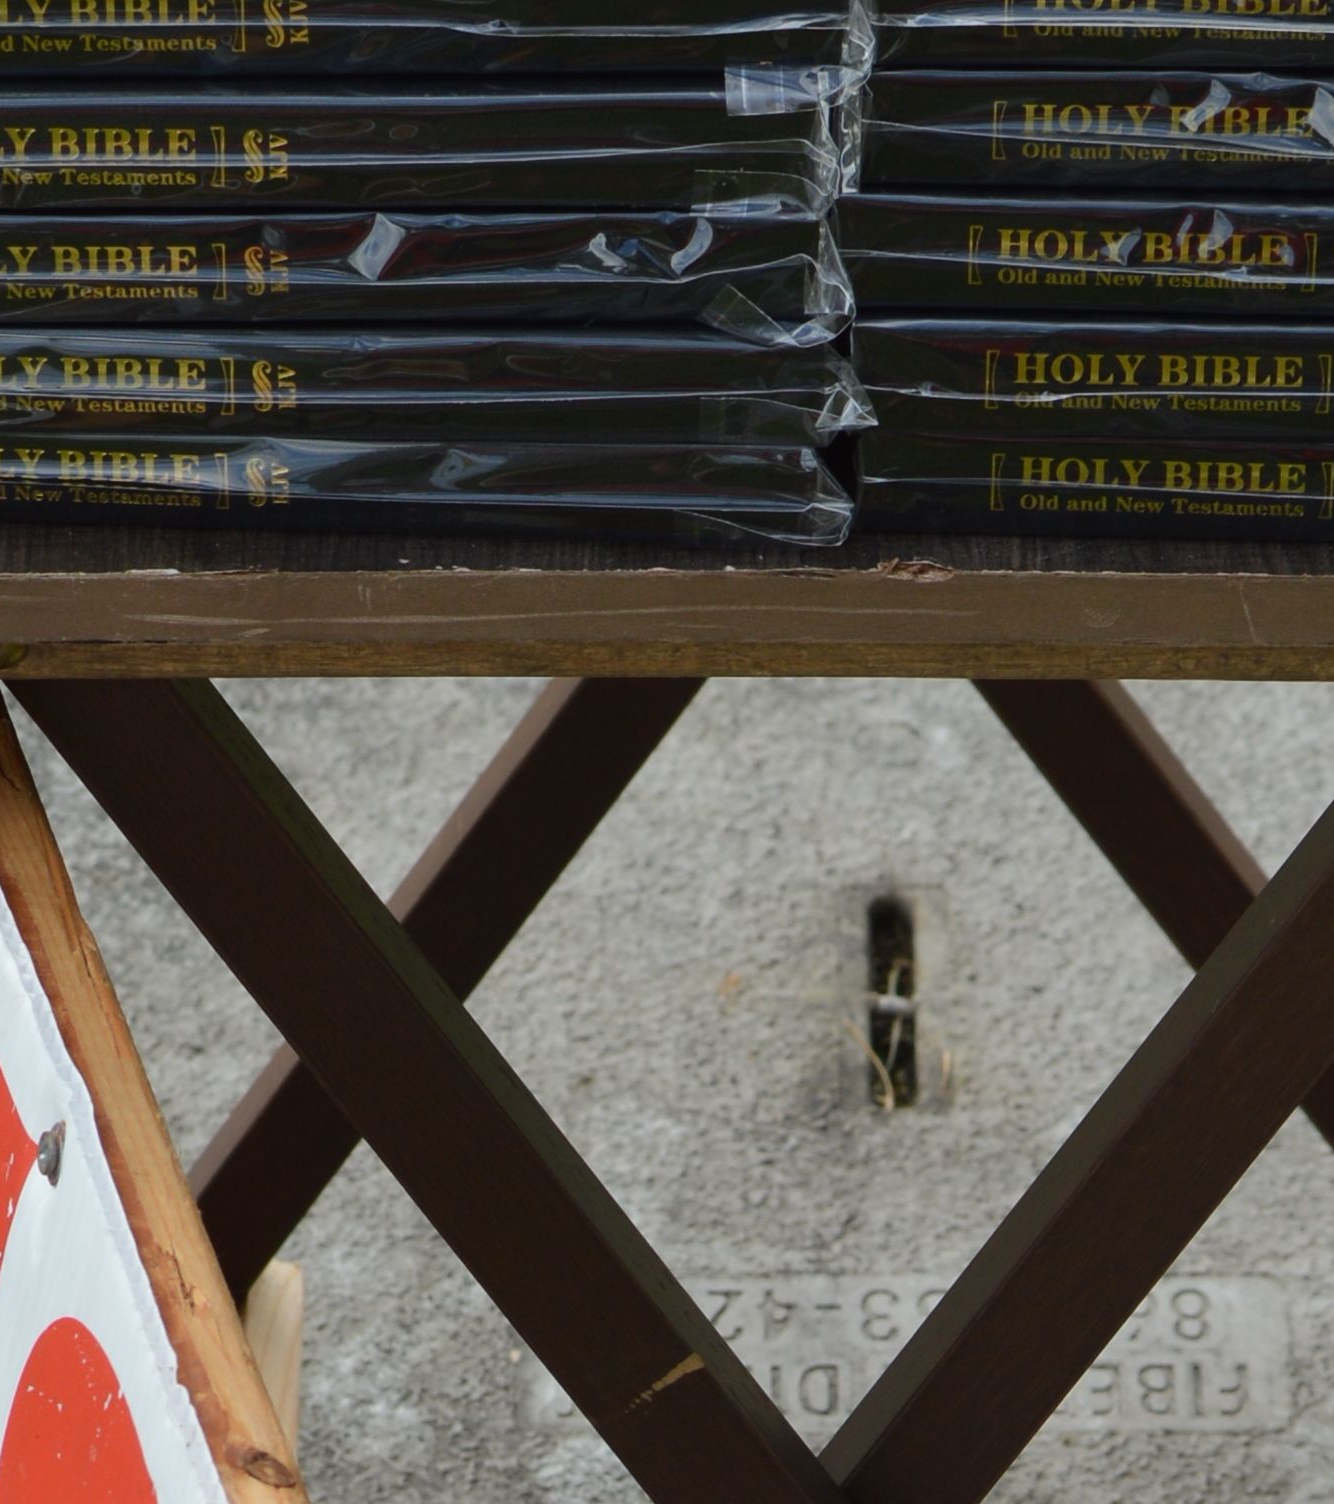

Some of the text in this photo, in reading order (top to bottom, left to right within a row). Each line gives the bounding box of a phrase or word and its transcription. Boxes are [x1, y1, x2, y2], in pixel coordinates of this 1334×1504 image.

[22, 35, 72, 53] New
[80, 34, 217, 52] Testaments
[1021, 105, 1155, 136] HOLY
[51, 127, 196, 161] BIBLE
[1022, 143, 1061, 160] Old
[1069, 143, 1112, 160] and
[1, 167, 51, 187] New
[59, 169, 196, 187] Testaments
[998, 229, 1289, 265] HOLY BIBLE
[54, 246, 197, 276] BIBLE
[998, 267, 1038, 285] Old
[1043, 268, 1085, 286] and
[1092, 270, 1141, 287] New
[2, 284, 56, 301] New
[63, 284, 198, 301] Testaments
[64, 357, 206, 391] BIBLE
[1014, 354, 1304, 387] HOLY BIBLE
[12, 396, 65, 414] New
[71, 397, 206, 415] Testaments
[1015, 392, 1303, 412] Old and New Testaments
[58, 449, 201, 485] BIBLE
[1020, 457, 1306, 494] HOLY BIBLE
[12, 485, 61, 503] New
[66, 487, 202, 507] Testaments
[1020, 494, 1305, 517] Old and New Testaments
